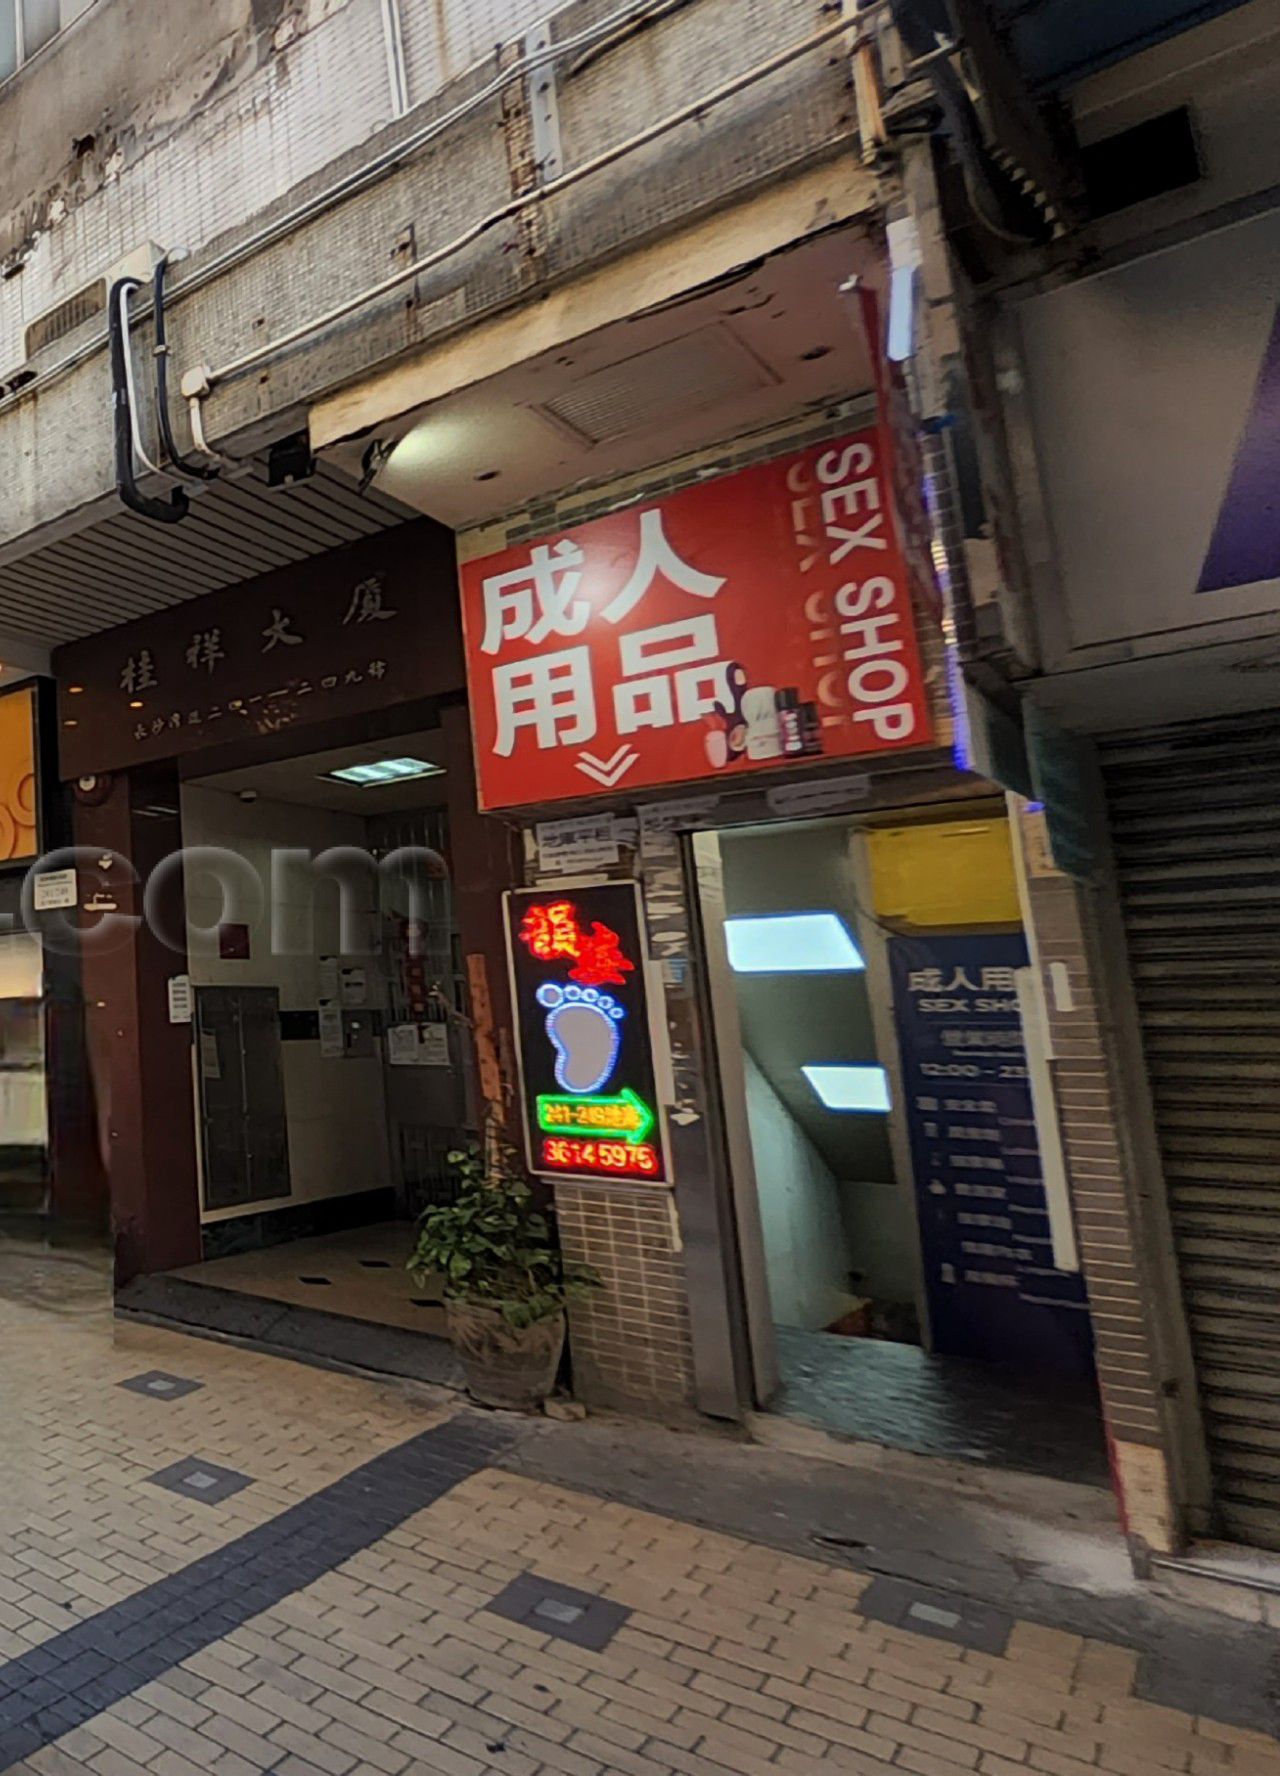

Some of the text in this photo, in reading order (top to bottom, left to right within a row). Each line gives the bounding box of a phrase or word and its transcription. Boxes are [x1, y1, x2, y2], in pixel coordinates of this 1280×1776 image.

[480, 508, 727, 655] 成人
[817, 441, 916, 741] SEX SHOP
[492, 613, 735, 758] 用品
[919, 999, 970, 1013] SEX
